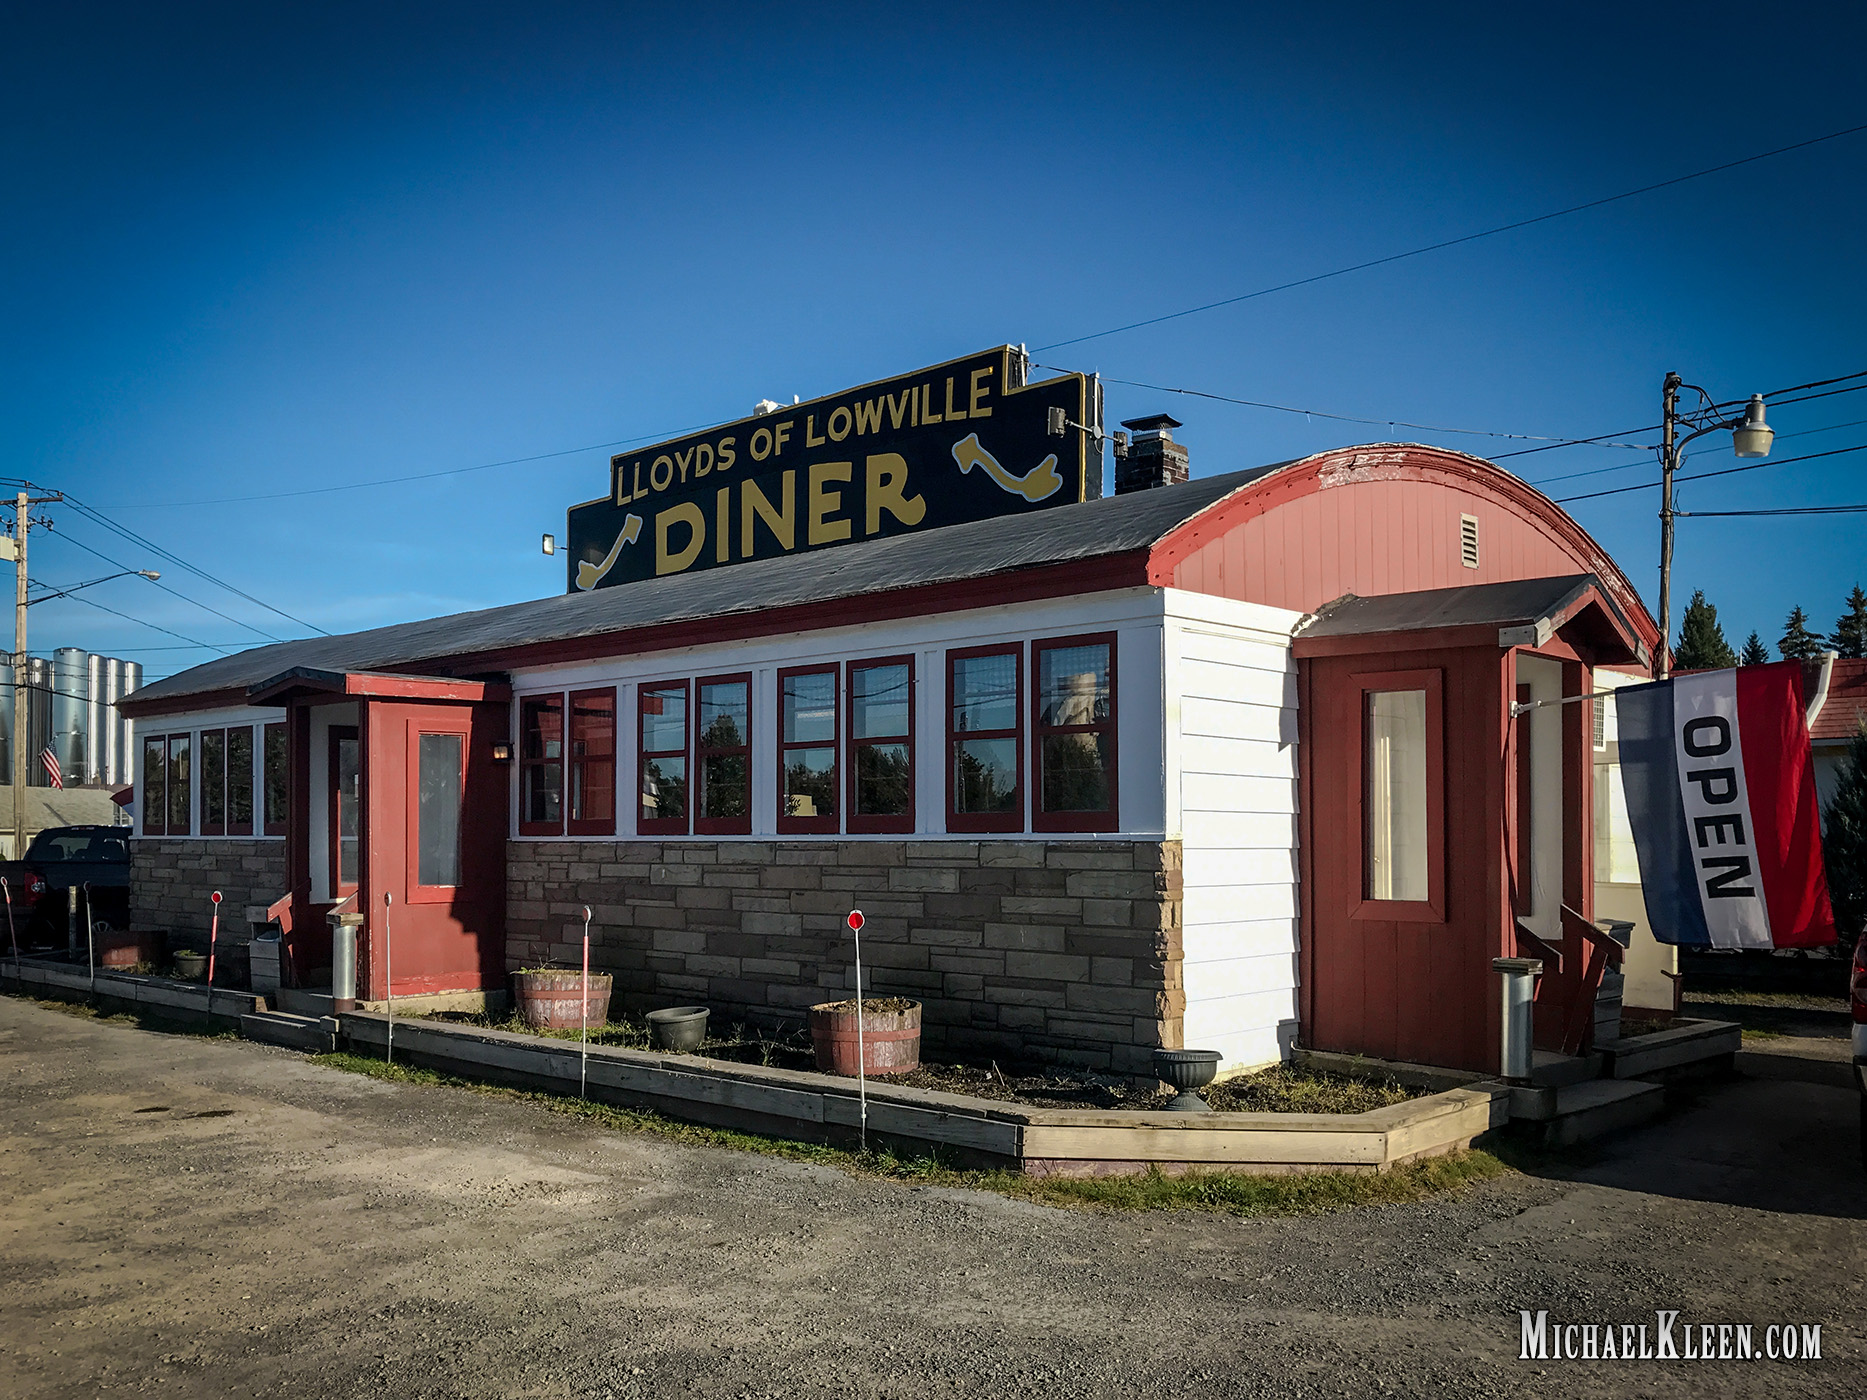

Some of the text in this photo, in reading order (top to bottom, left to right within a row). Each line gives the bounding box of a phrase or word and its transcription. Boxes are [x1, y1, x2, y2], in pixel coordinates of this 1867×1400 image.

[617, 366, 994, 506] LLOYDS OF LOWVILLE
[655, 452, 927, 576] DINER
[1683, 715, 1756, 899] OPEN
